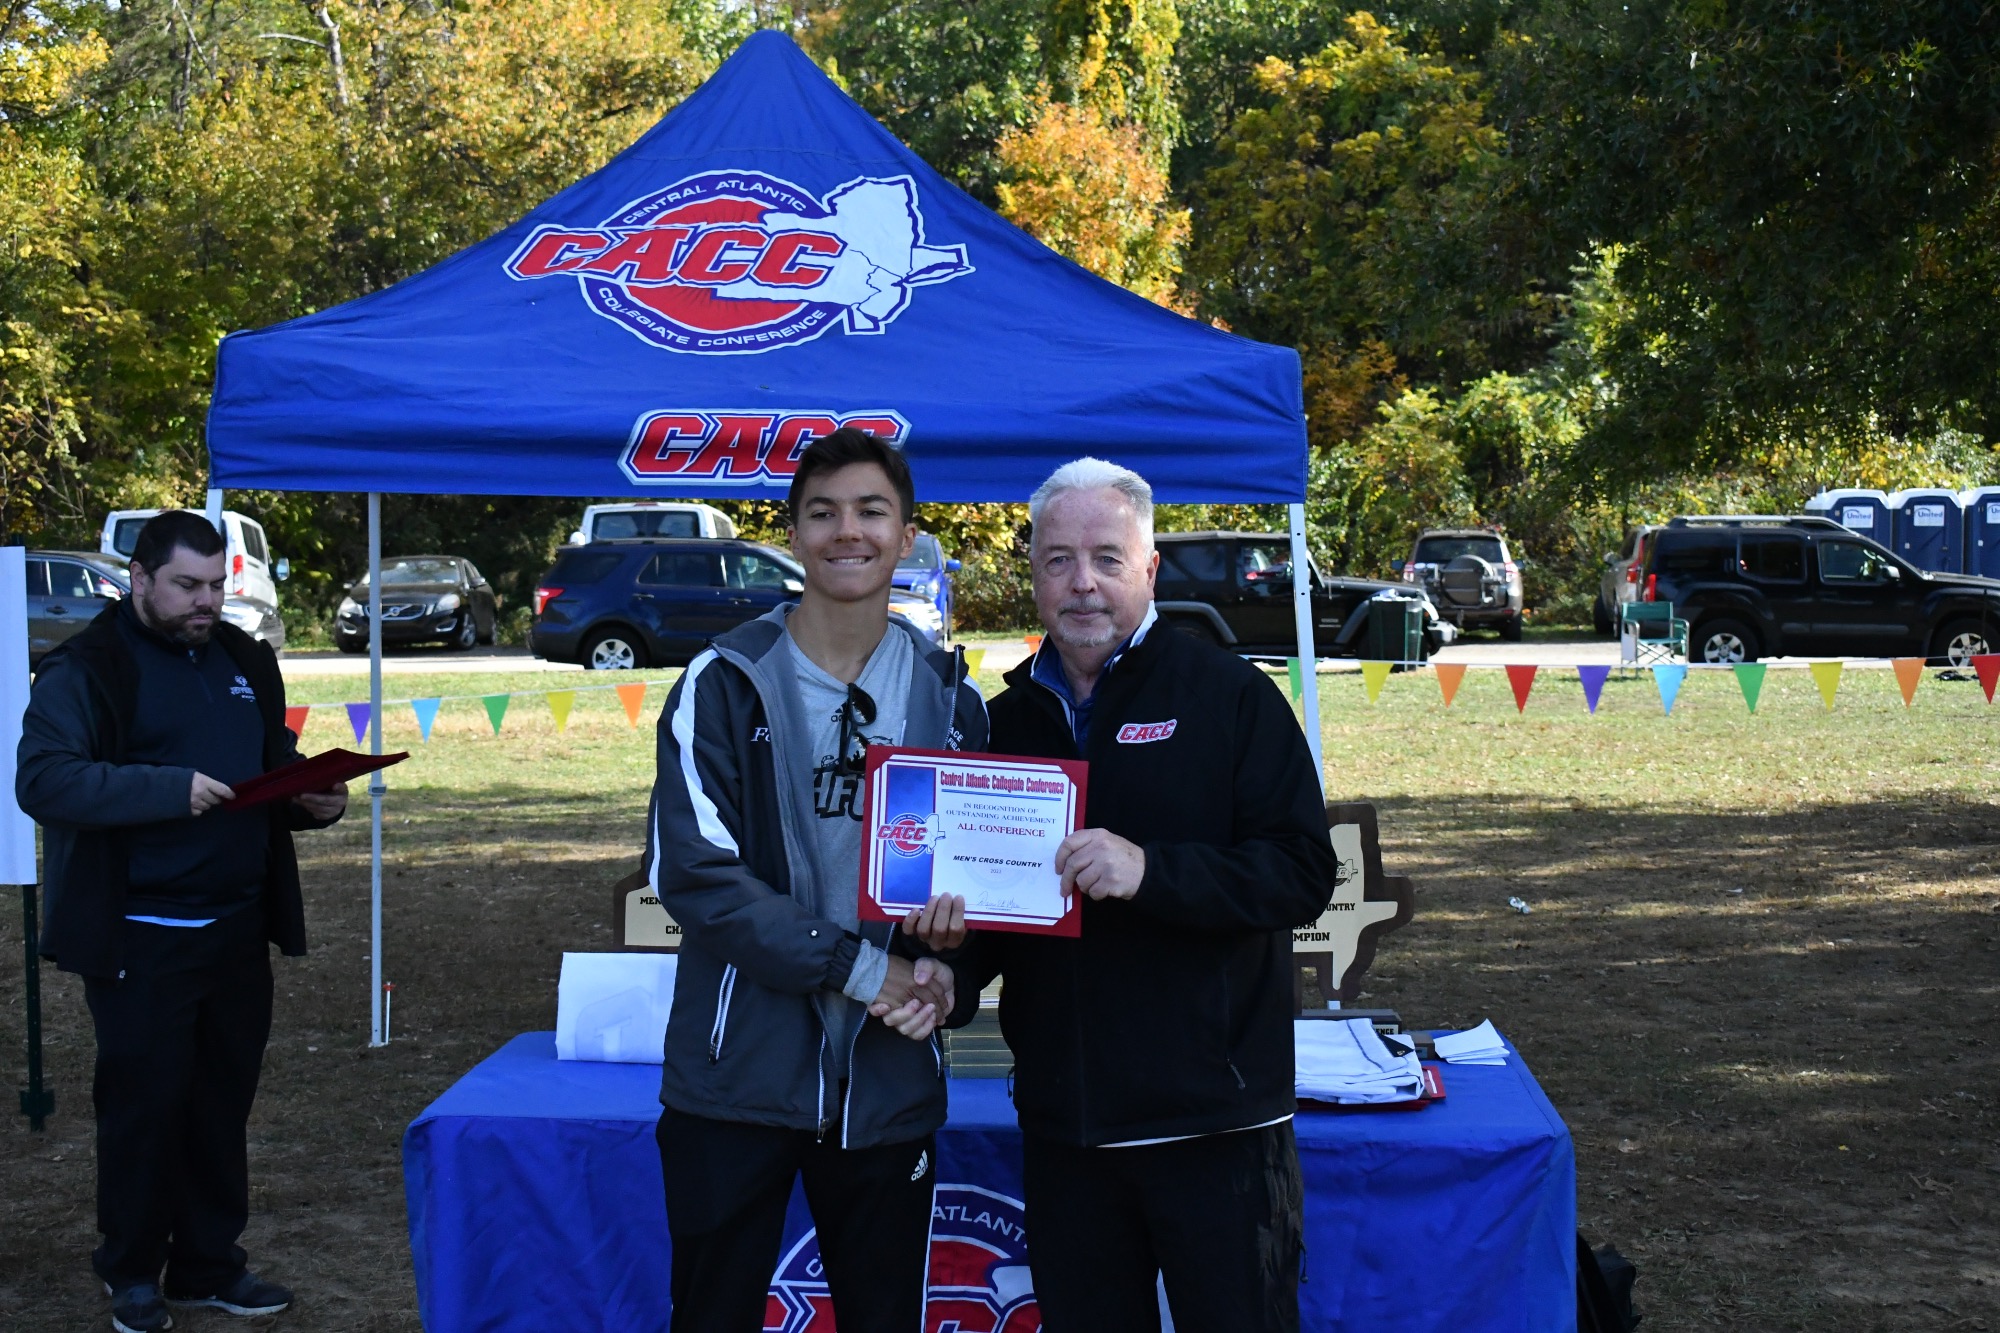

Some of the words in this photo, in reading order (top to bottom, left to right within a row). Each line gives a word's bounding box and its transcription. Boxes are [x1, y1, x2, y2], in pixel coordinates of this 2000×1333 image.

[622, 185, 707, 225] CENTRAL
[715, 179, 807, 212] ATLANTIC
[504, 225, 848, 289] CACC
[697, 309, 828, 347] CONFERENCE
[1118, 720, 1177, 742] CACC
[940, 770, 964, 787] Central
[965, 772, 990, 789] Atlantic
[991, 775, 1024, 793] Collegiate
[1026, 777, 1064, 795] Conference
[973, 803, 1026, 813] RECOGNITION
[946, 809, 1000, 820] OUTSTANDING
[1002, 815, 1057, 824] ACHIEVEMENT
[877, 825, 928, 842] CACC
[957, 822, 976, 831] ALL
[979, 824, 1045, 838] CONFERENCE
[979, 857, 1004, 865] CROSS
[1005, 859, 1043, 868] COUNTRY
[640, 896, 662, 905] MEN
[1326, 902, 1356, 911] UNTRY
[1293, 932, 1330, 941] MPION
[933, 1205, 1027, 1249] ATLANT
